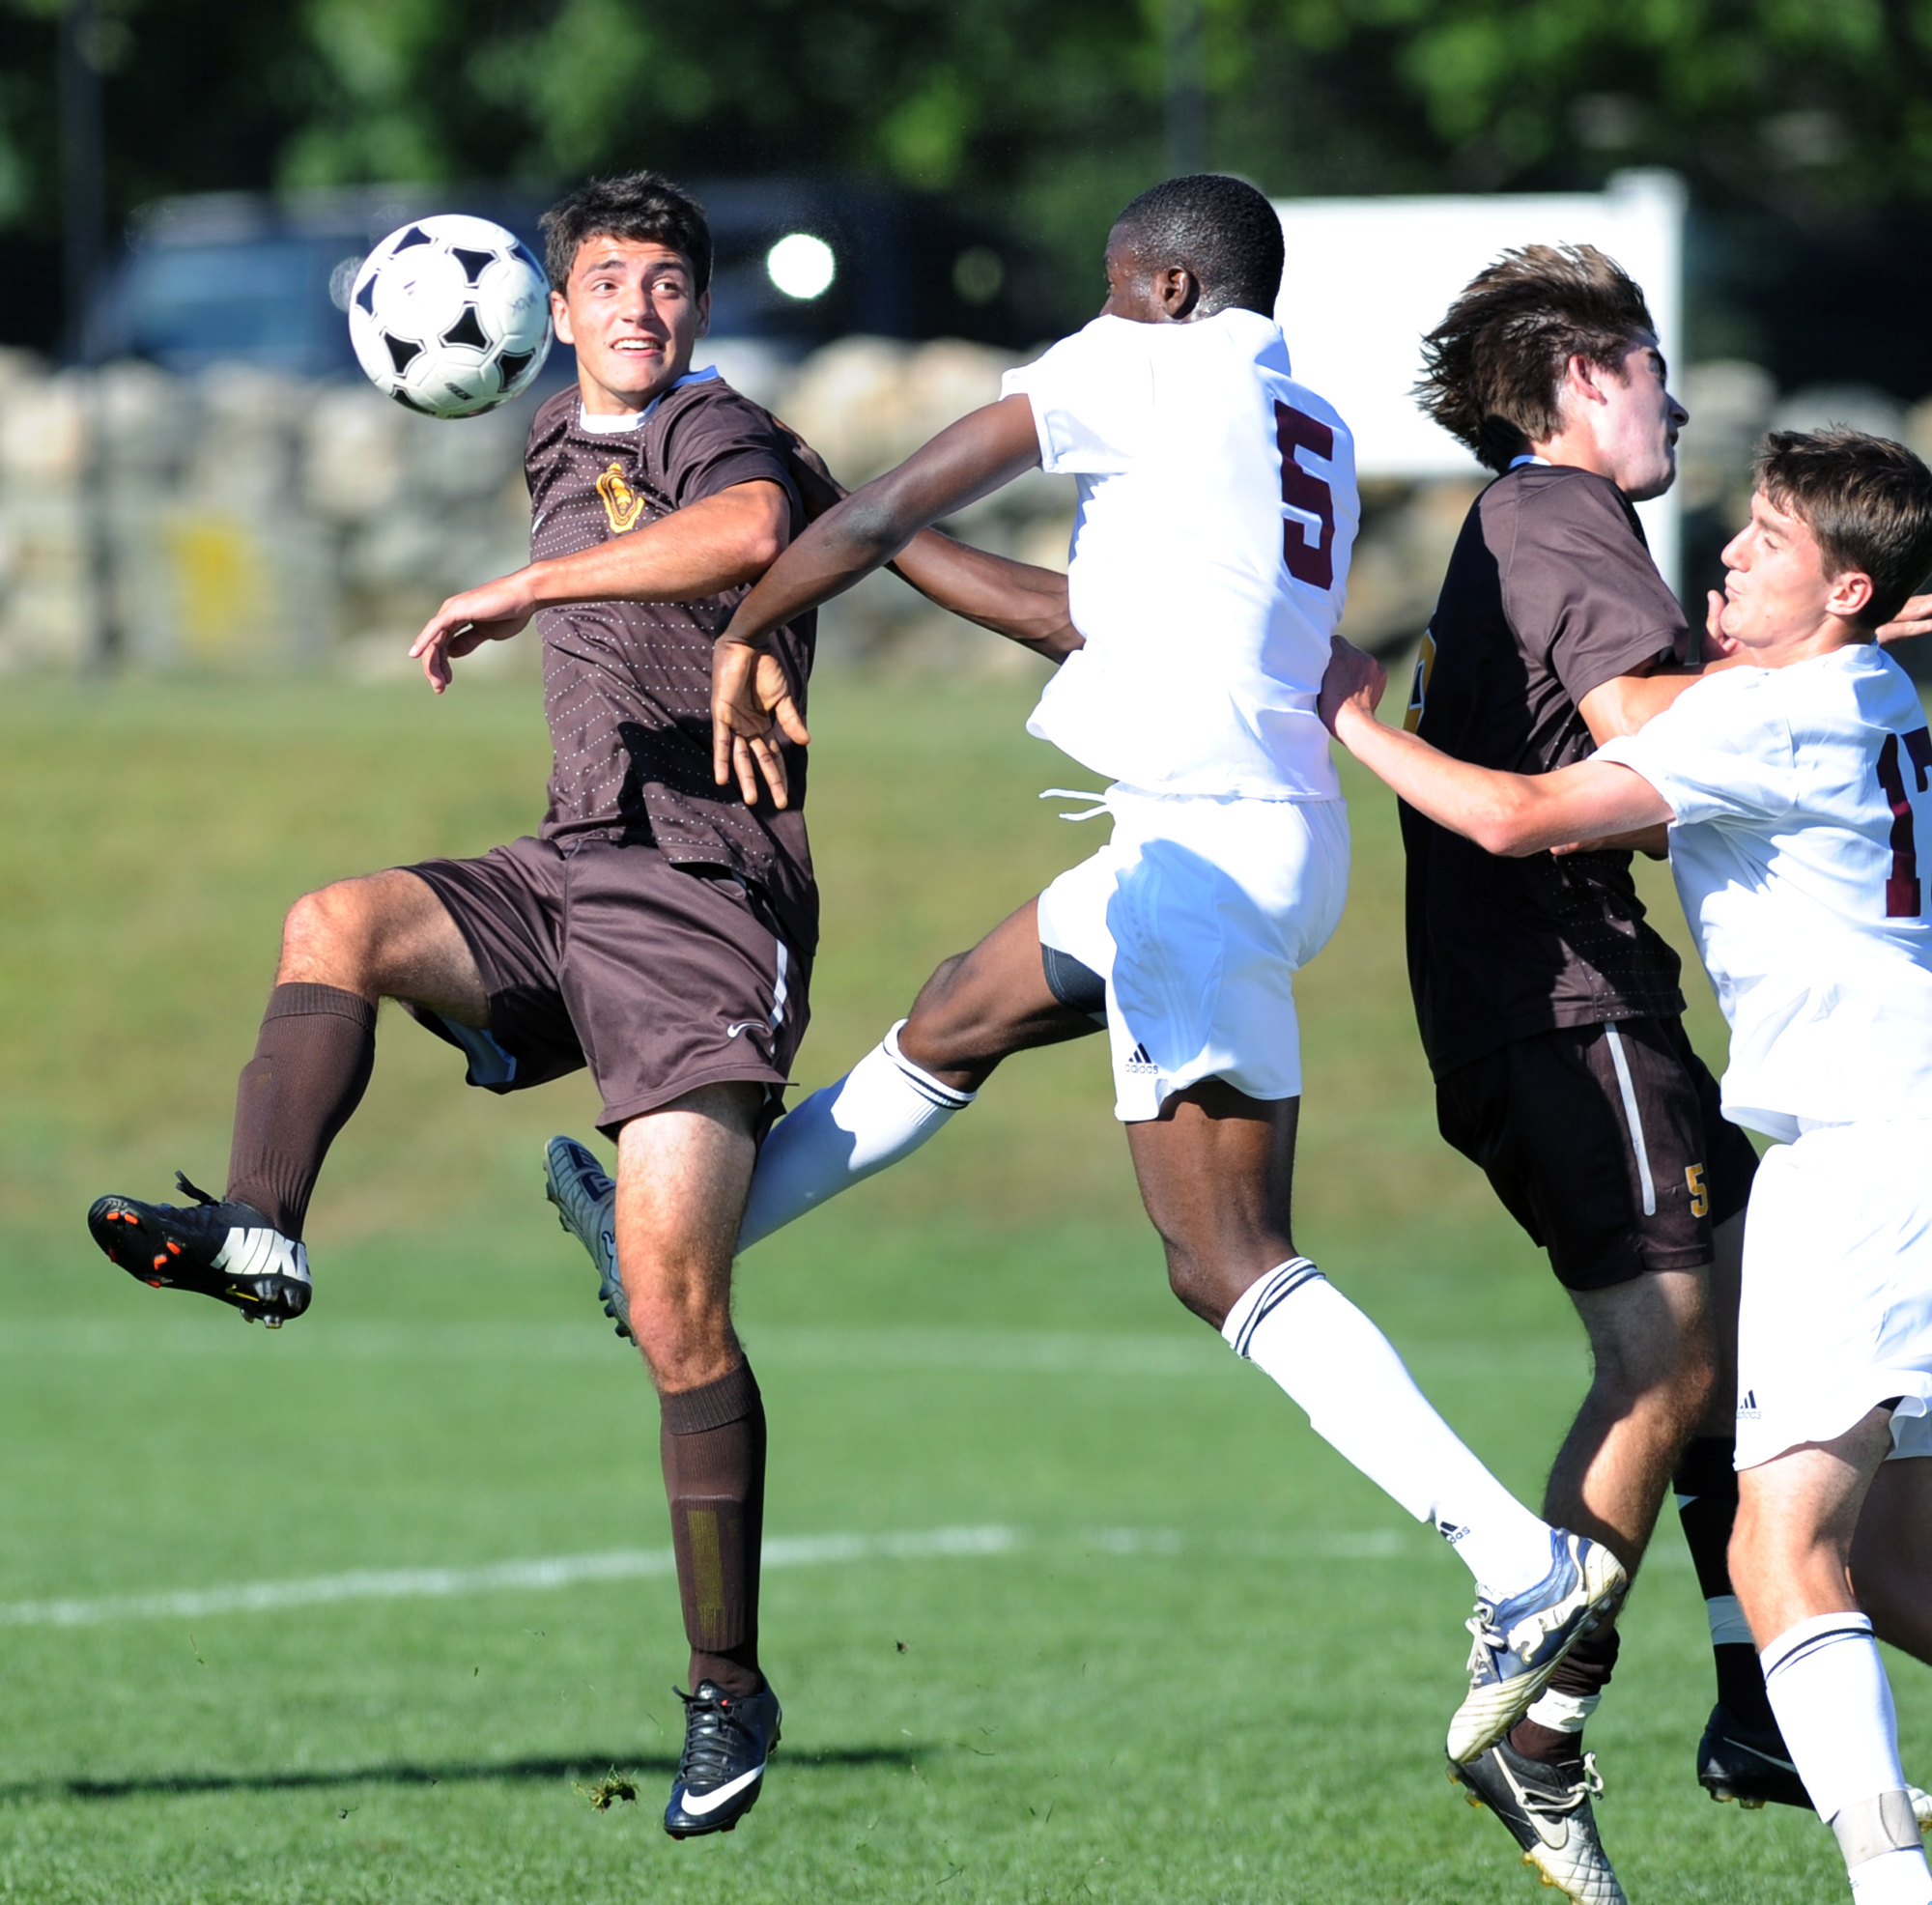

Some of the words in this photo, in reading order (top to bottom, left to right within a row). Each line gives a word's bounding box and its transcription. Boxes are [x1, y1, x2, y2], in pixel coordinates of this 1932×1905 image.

[1274, 398, 1336, 591] 5
[1124, 1064, 1158, 1074] adidas
[1685, 1162, 1709, 1218] 5
